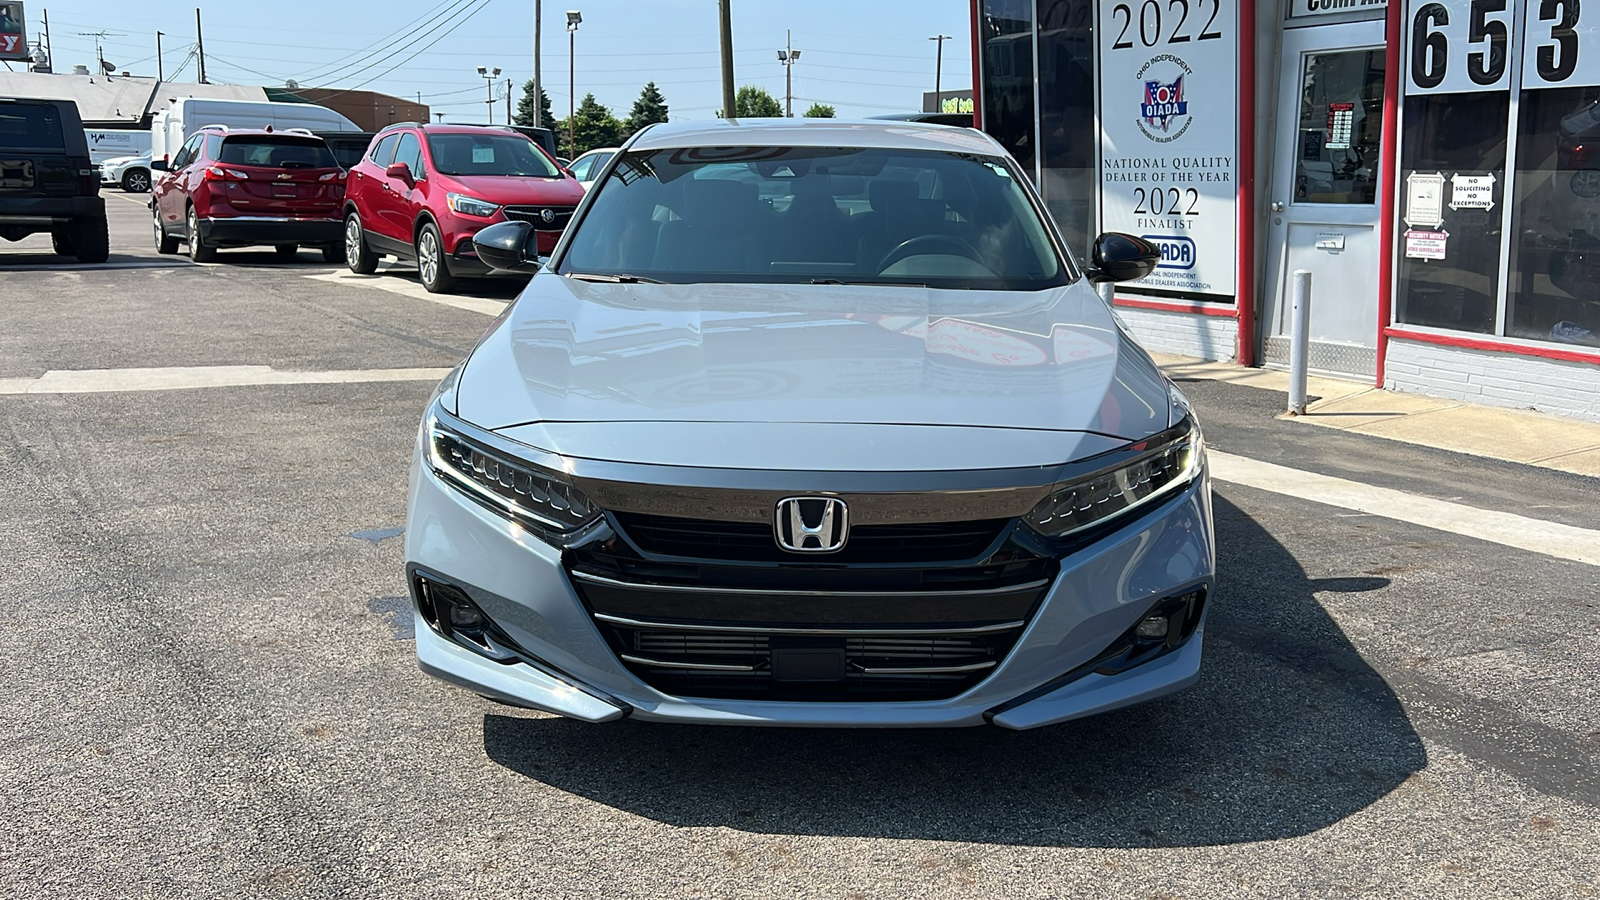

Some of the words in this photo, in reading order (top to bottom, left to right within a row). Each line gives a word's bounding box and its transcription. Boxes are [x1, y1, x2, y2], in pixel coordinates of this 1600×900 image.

[1112, 0, 1222, 50] 2022
[1136, 61, 1150, 80] OHIO
[1150, 54, 1193, 76] INDEPENDENT
[1146, 103, 1180, 117] OIADA
[1135, 118, 1155, 142] AUTOMOBILE
[1172, 115, 1193, 142] ASSOCIATION
[1104, 158, 1167, 169] NATIONAL
[1172, 157, 1232, 170] QUALITY
[1105, 172, 1147, 182] DEALER
[1151, 172, 1166, 182] OF
[1171, 172, 1193, 182] THE
[1199, 172, 1230, 182] YEAR
[1133, 186, 1200, 216] 2022
[1137, 218, 1193, 230] FINALIST
[1162, 271, 1197, 279] INDEPENDENT
[1155, 279, 1176, 287] DEALERS
[1176, 280, 1211, 289] ASSOCIATION
